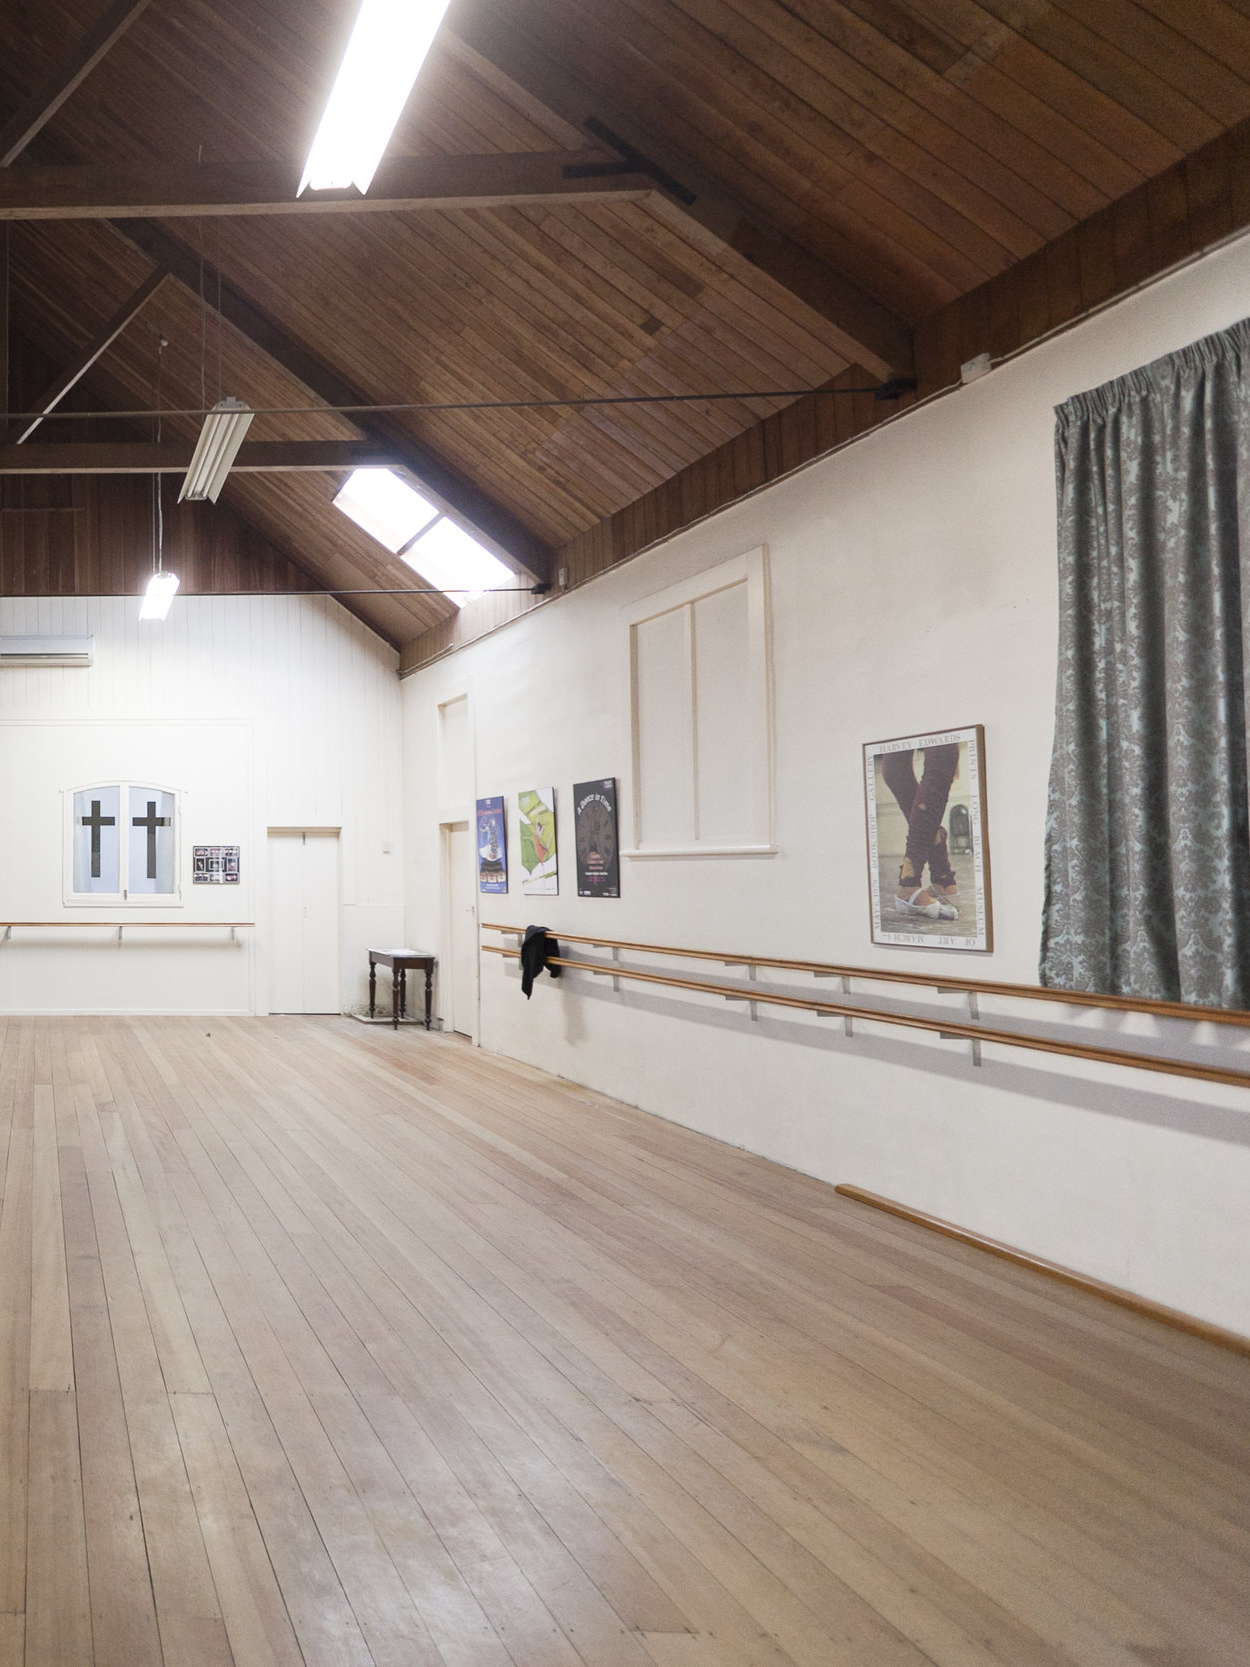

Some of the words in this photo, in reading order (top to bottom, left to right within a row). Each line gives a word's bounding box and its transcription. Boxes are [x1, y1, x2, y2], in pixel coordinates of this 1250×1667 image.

[879, 741, 911, 753] HARVEY
[918, 735, 961, 747] EDWARDS
[968, 740, 977, 780] PRINTS
[971, 795, 979, 825] LONG
[973, 835, 982, 873] BEACH
